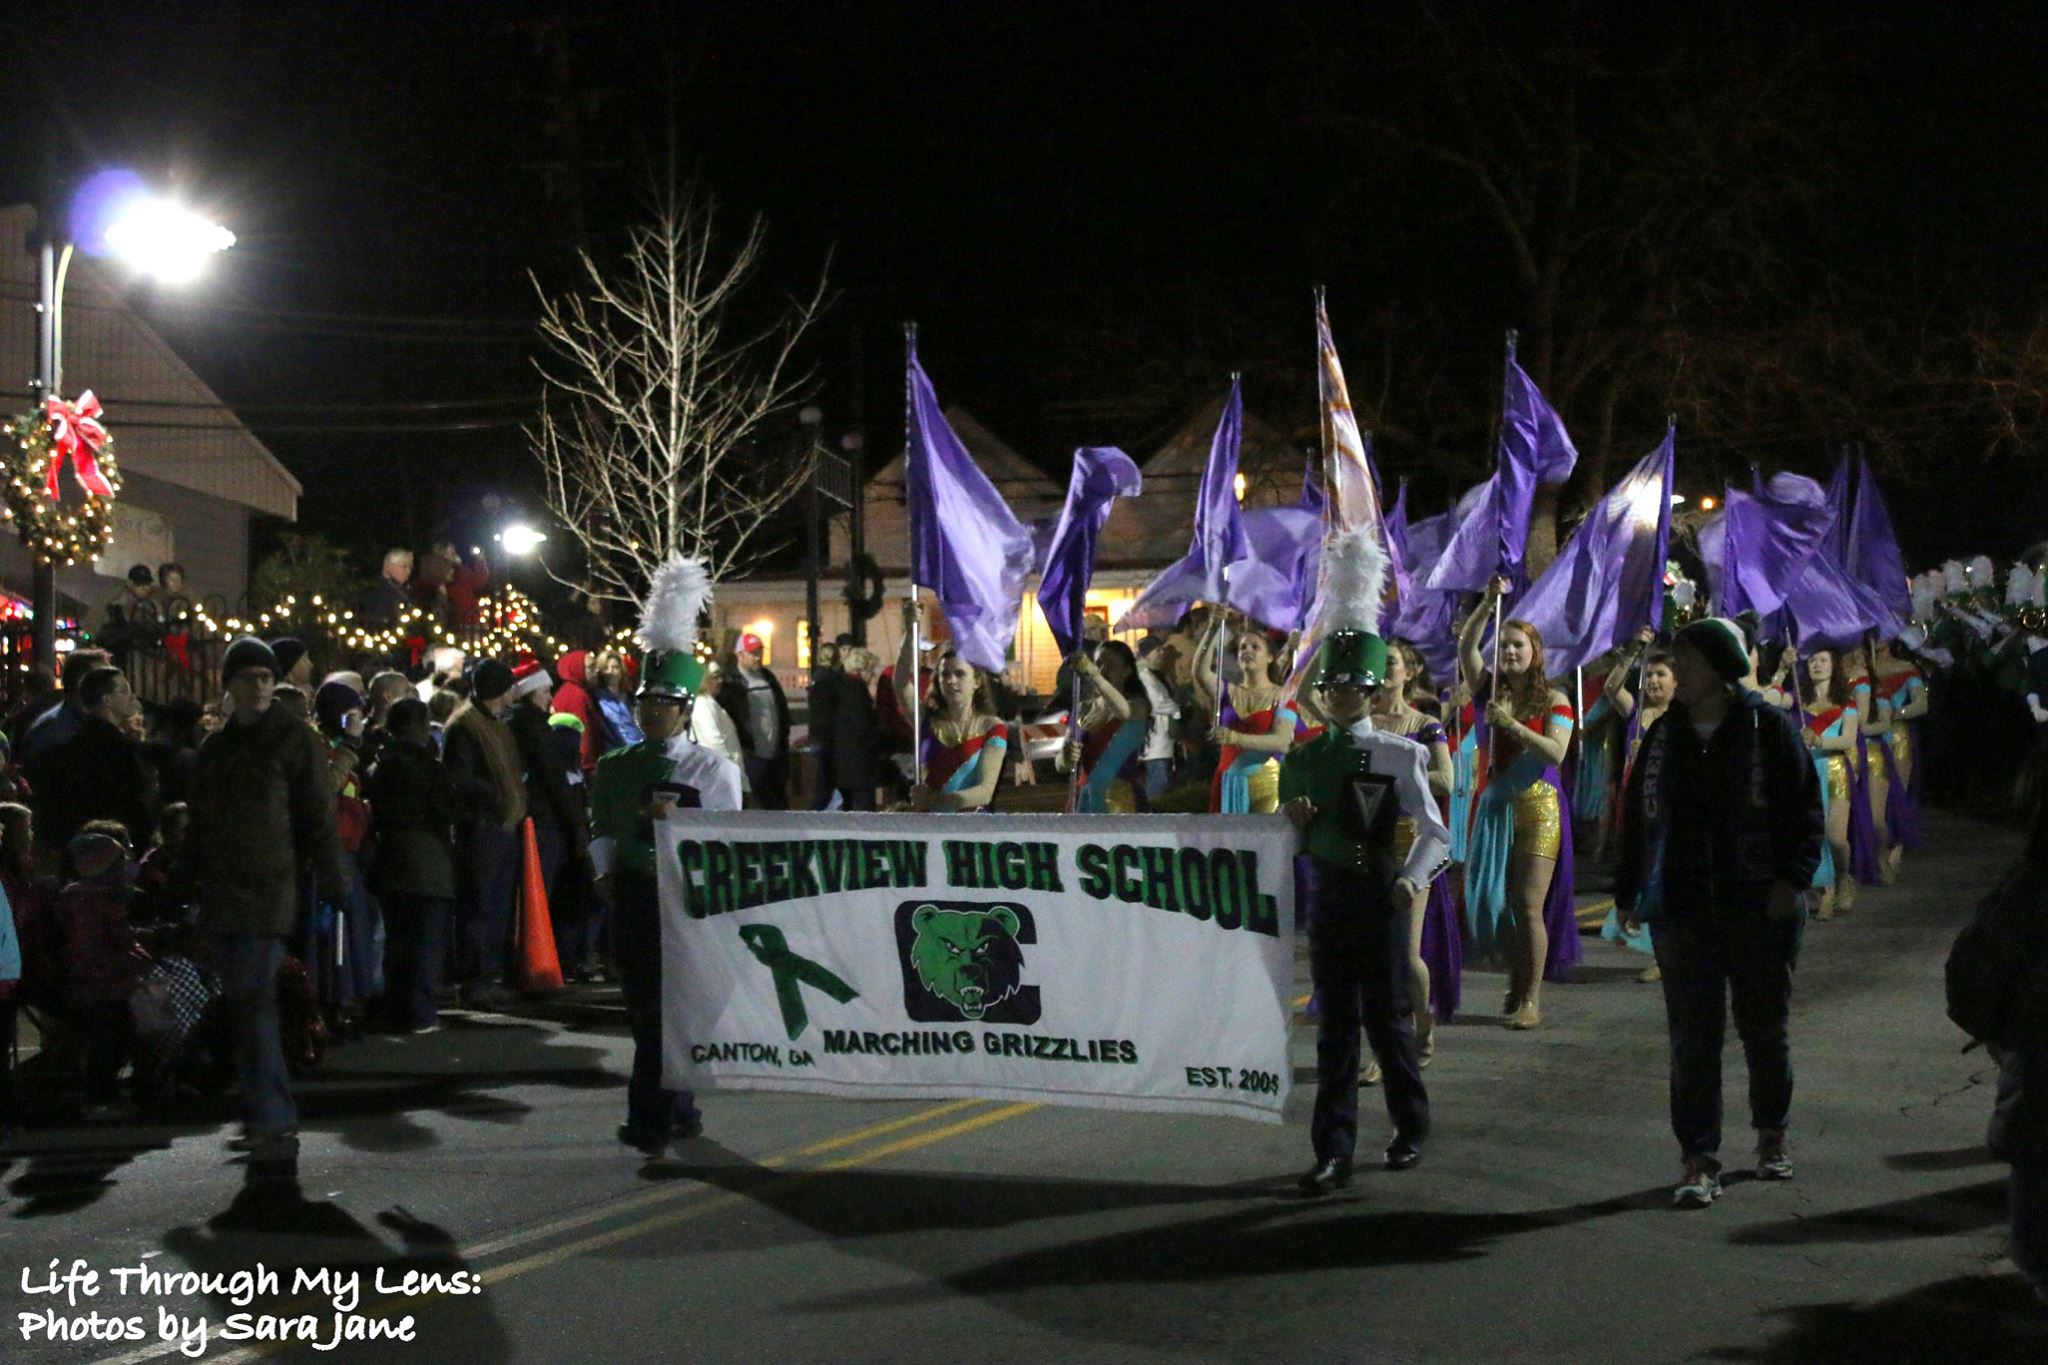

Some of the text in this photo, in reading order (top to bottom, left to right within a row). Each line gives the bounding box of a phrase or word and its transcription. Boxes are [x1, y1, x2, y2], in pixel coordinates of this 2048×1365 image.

[677, 838, 1280, 937] CREEKVIEW HIGH SCHOOL
[691, 1042, 815, 1068] CANTON, GA
[823, 1030, 1139, 1065] MARCHING GRIZZLIES
[1185, 1066, 1233, 1090] EST.
